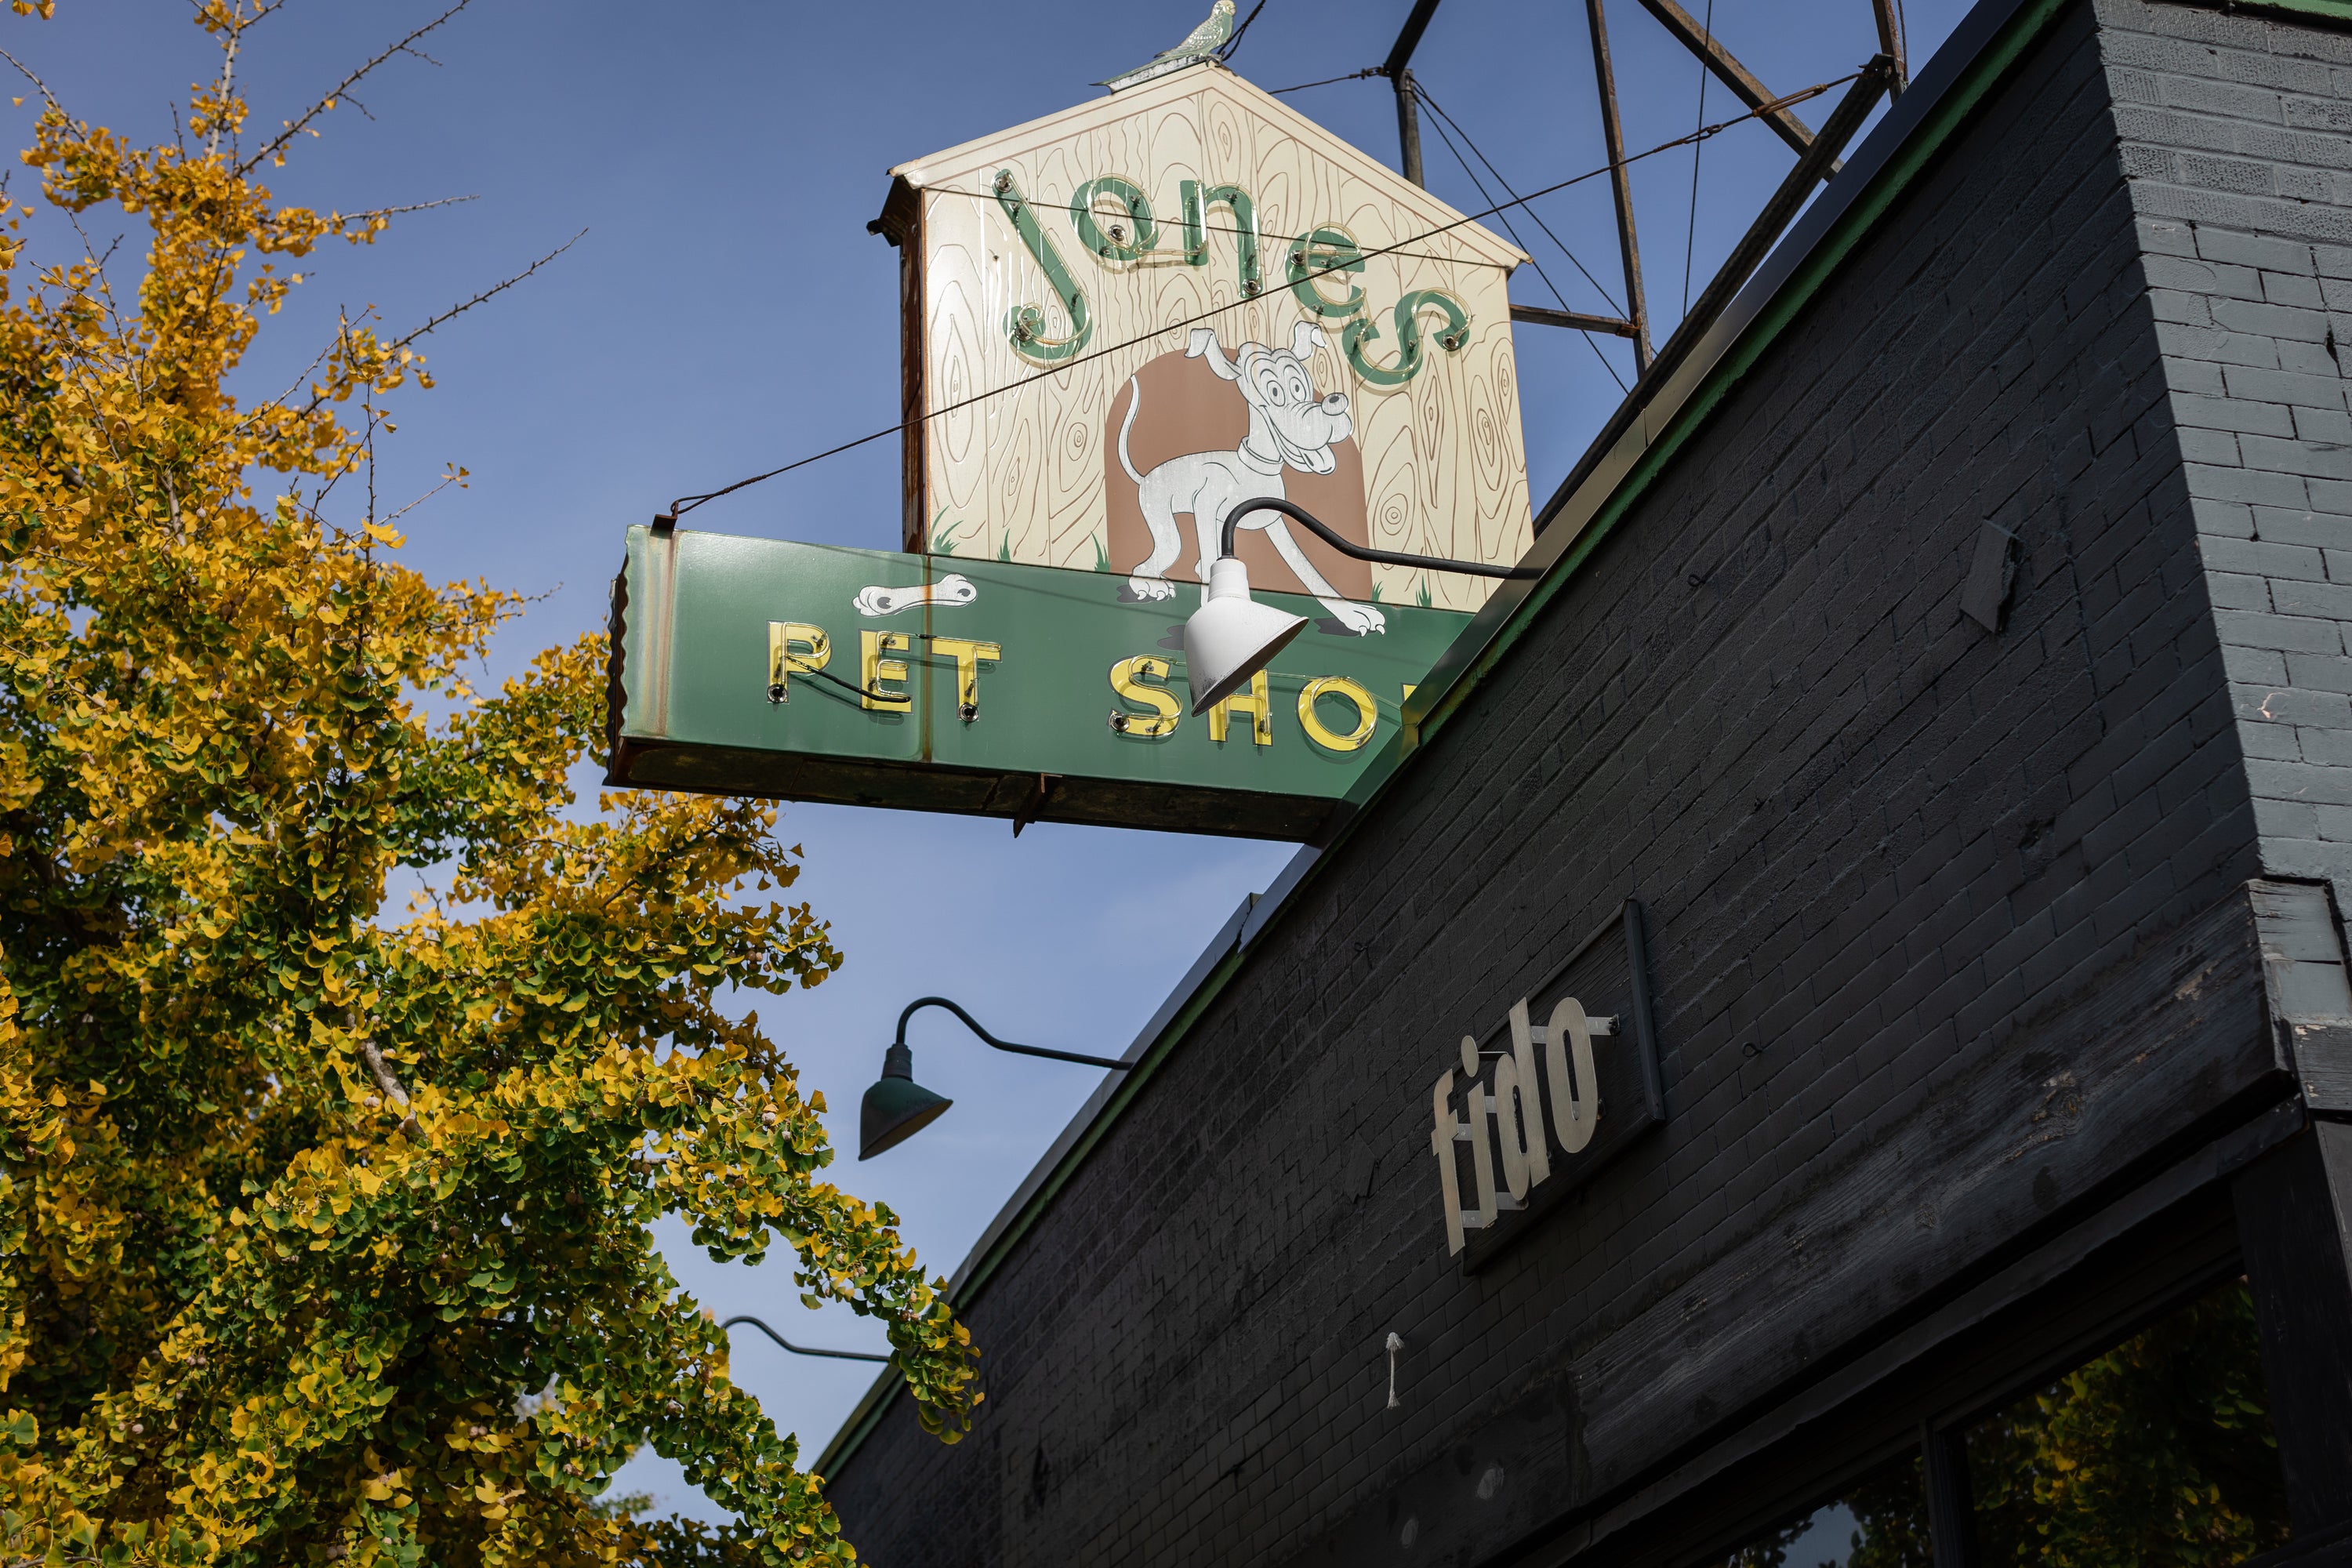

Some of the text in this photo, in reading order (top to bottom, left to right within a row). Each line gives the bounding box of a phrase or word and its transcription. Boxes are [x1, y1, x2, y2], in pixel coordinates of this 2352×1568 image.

[993, 168, 1472, 392] Jones
[766, 619, 1418, 753] PET SHO
[1431, 996, 1599, 1258] fido
